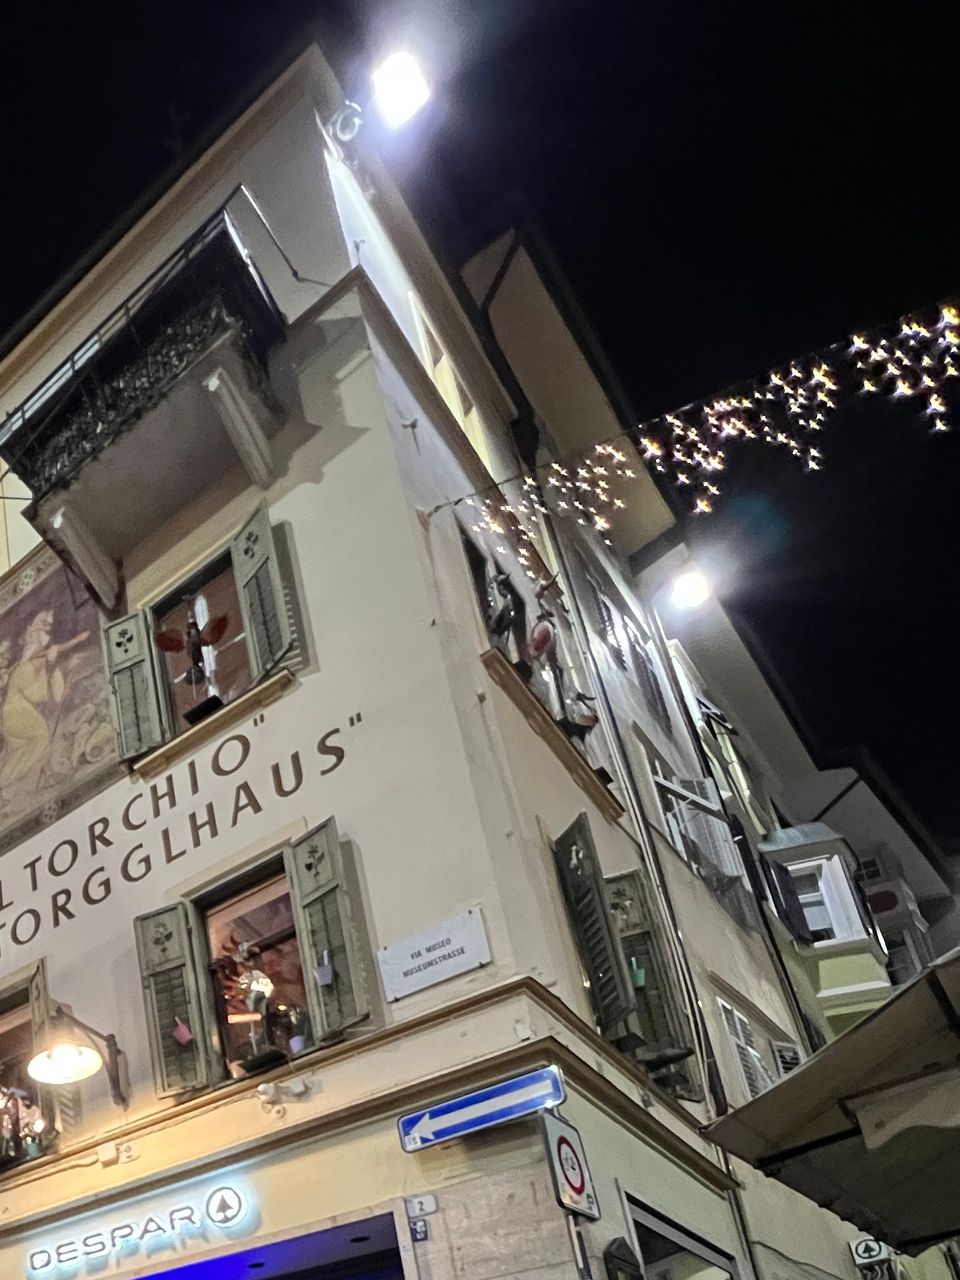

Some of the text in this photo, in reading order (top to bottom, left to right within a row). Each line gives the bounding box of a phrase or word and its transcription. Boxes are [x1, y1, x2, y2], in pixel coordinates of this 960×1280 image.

[402, 946, 466, 977] MUSEUMSTRASSE
[410, 937, 451, 960] VIA MUSEO
[417, 1200, 426, 1212] 2
[30, 1206, 196, 1270] DESPAR
